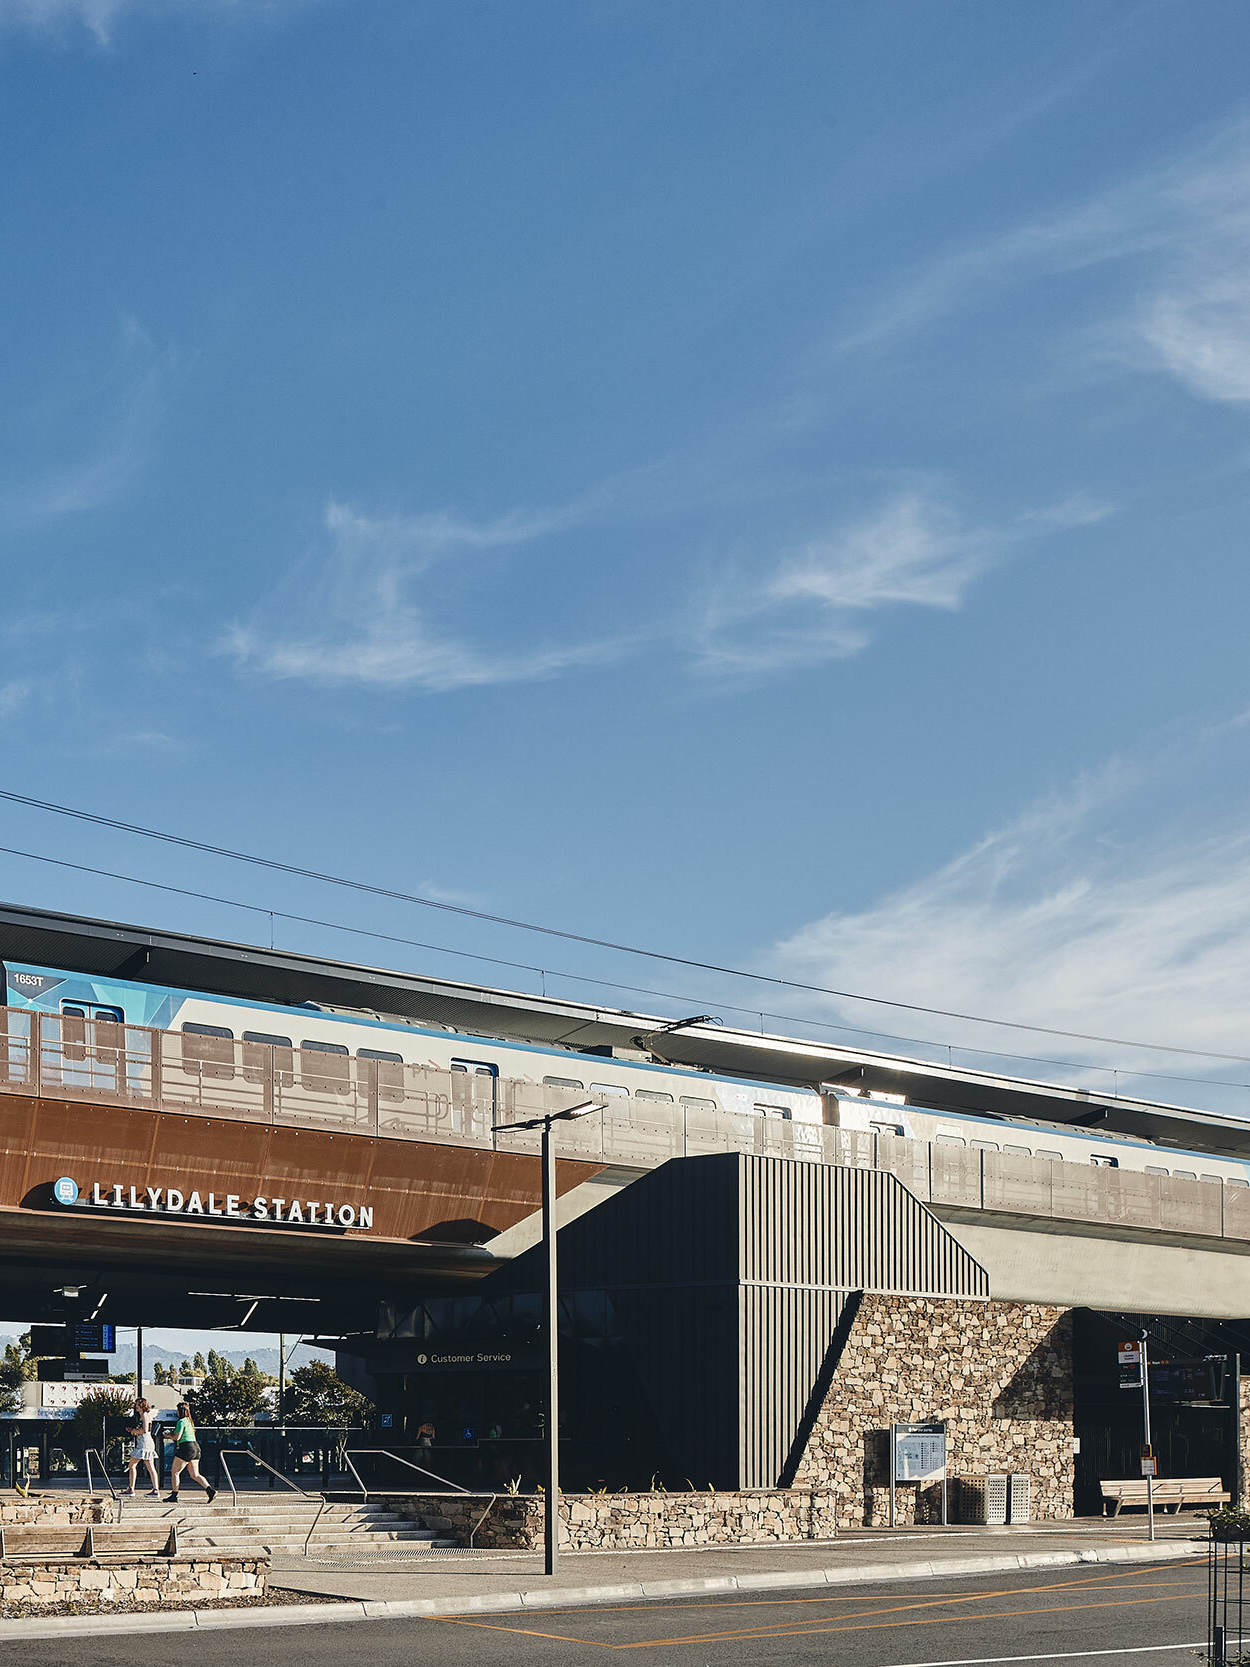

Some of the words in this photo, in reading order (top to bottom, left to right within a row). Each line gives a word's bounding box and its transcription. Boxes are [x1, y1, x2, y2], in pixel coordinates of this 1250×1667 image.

[14, 973, 44, 987] 1653T
[93, 1182, 241, 1216] LILYDALE
[254, 1196, 374, 1227] STATION
[430, 1353, 474, 1363] Customer
[477, 1352, 512, 1362] Service
